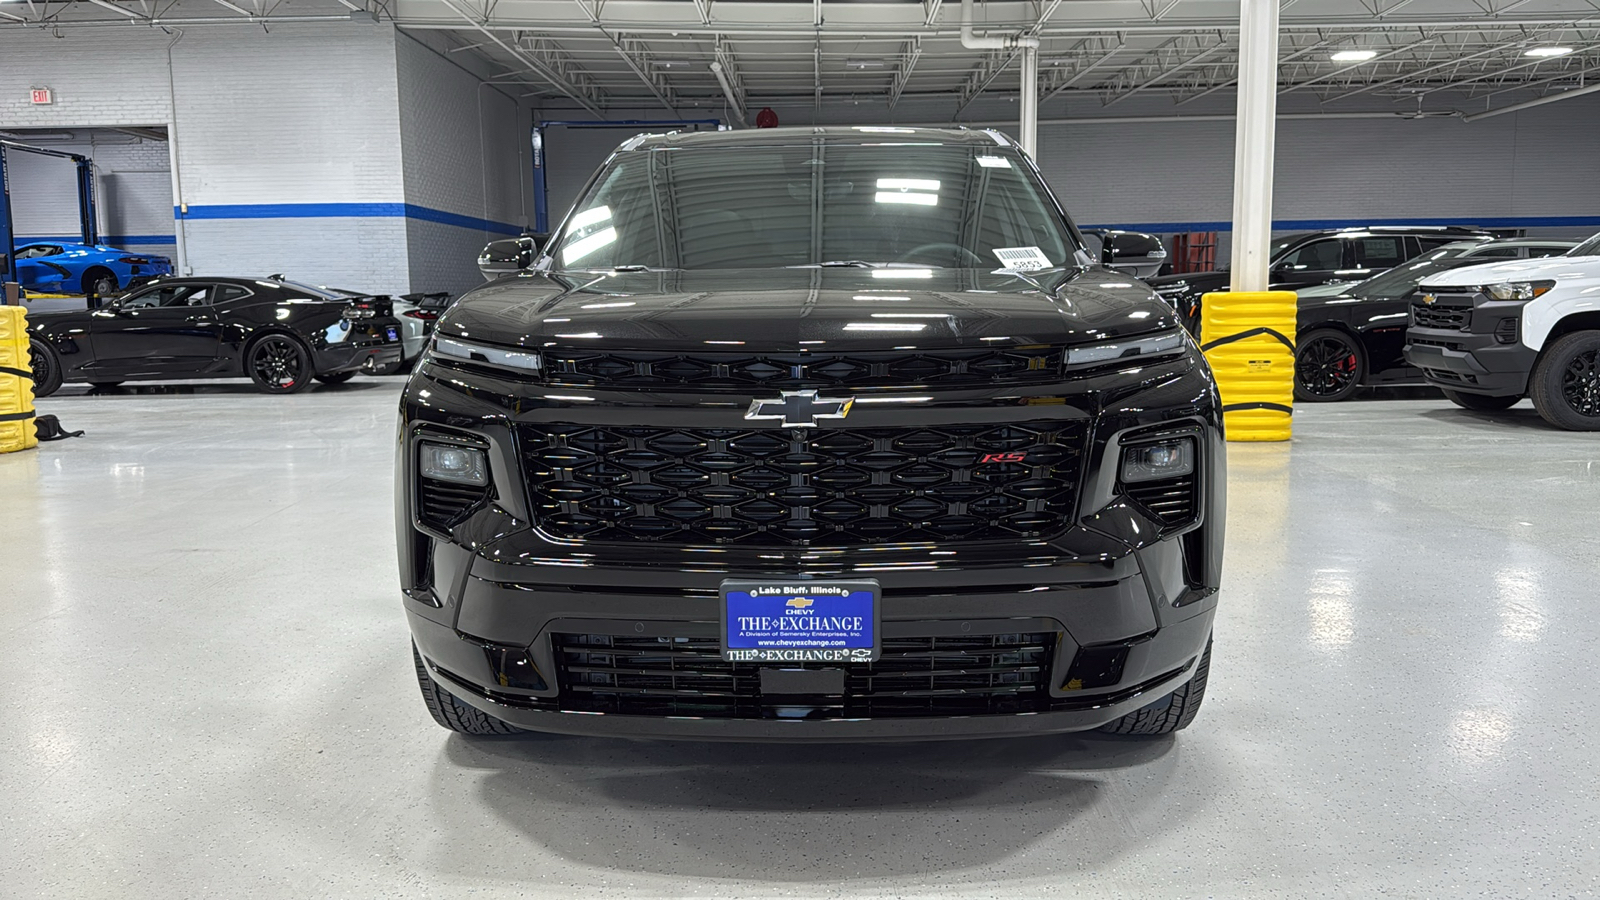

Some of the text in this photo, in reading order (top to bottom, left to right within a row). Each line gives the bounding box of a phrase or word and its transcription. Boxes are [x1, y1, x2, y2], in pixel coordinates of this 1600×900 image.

[33, 90, 48, 102] EXIT
[1013, 260, 1042, 269] 5853
[981, 453, 1026, 463] RS
[758, 586, 841, 594] Lake Bluff, Illinois
[738, 616, 863, 631] THE EXCHANGE
[758, 640, 846, 648] www.chevyexchange.com
[727, 650, 843, 661] THE EXCHANGE
